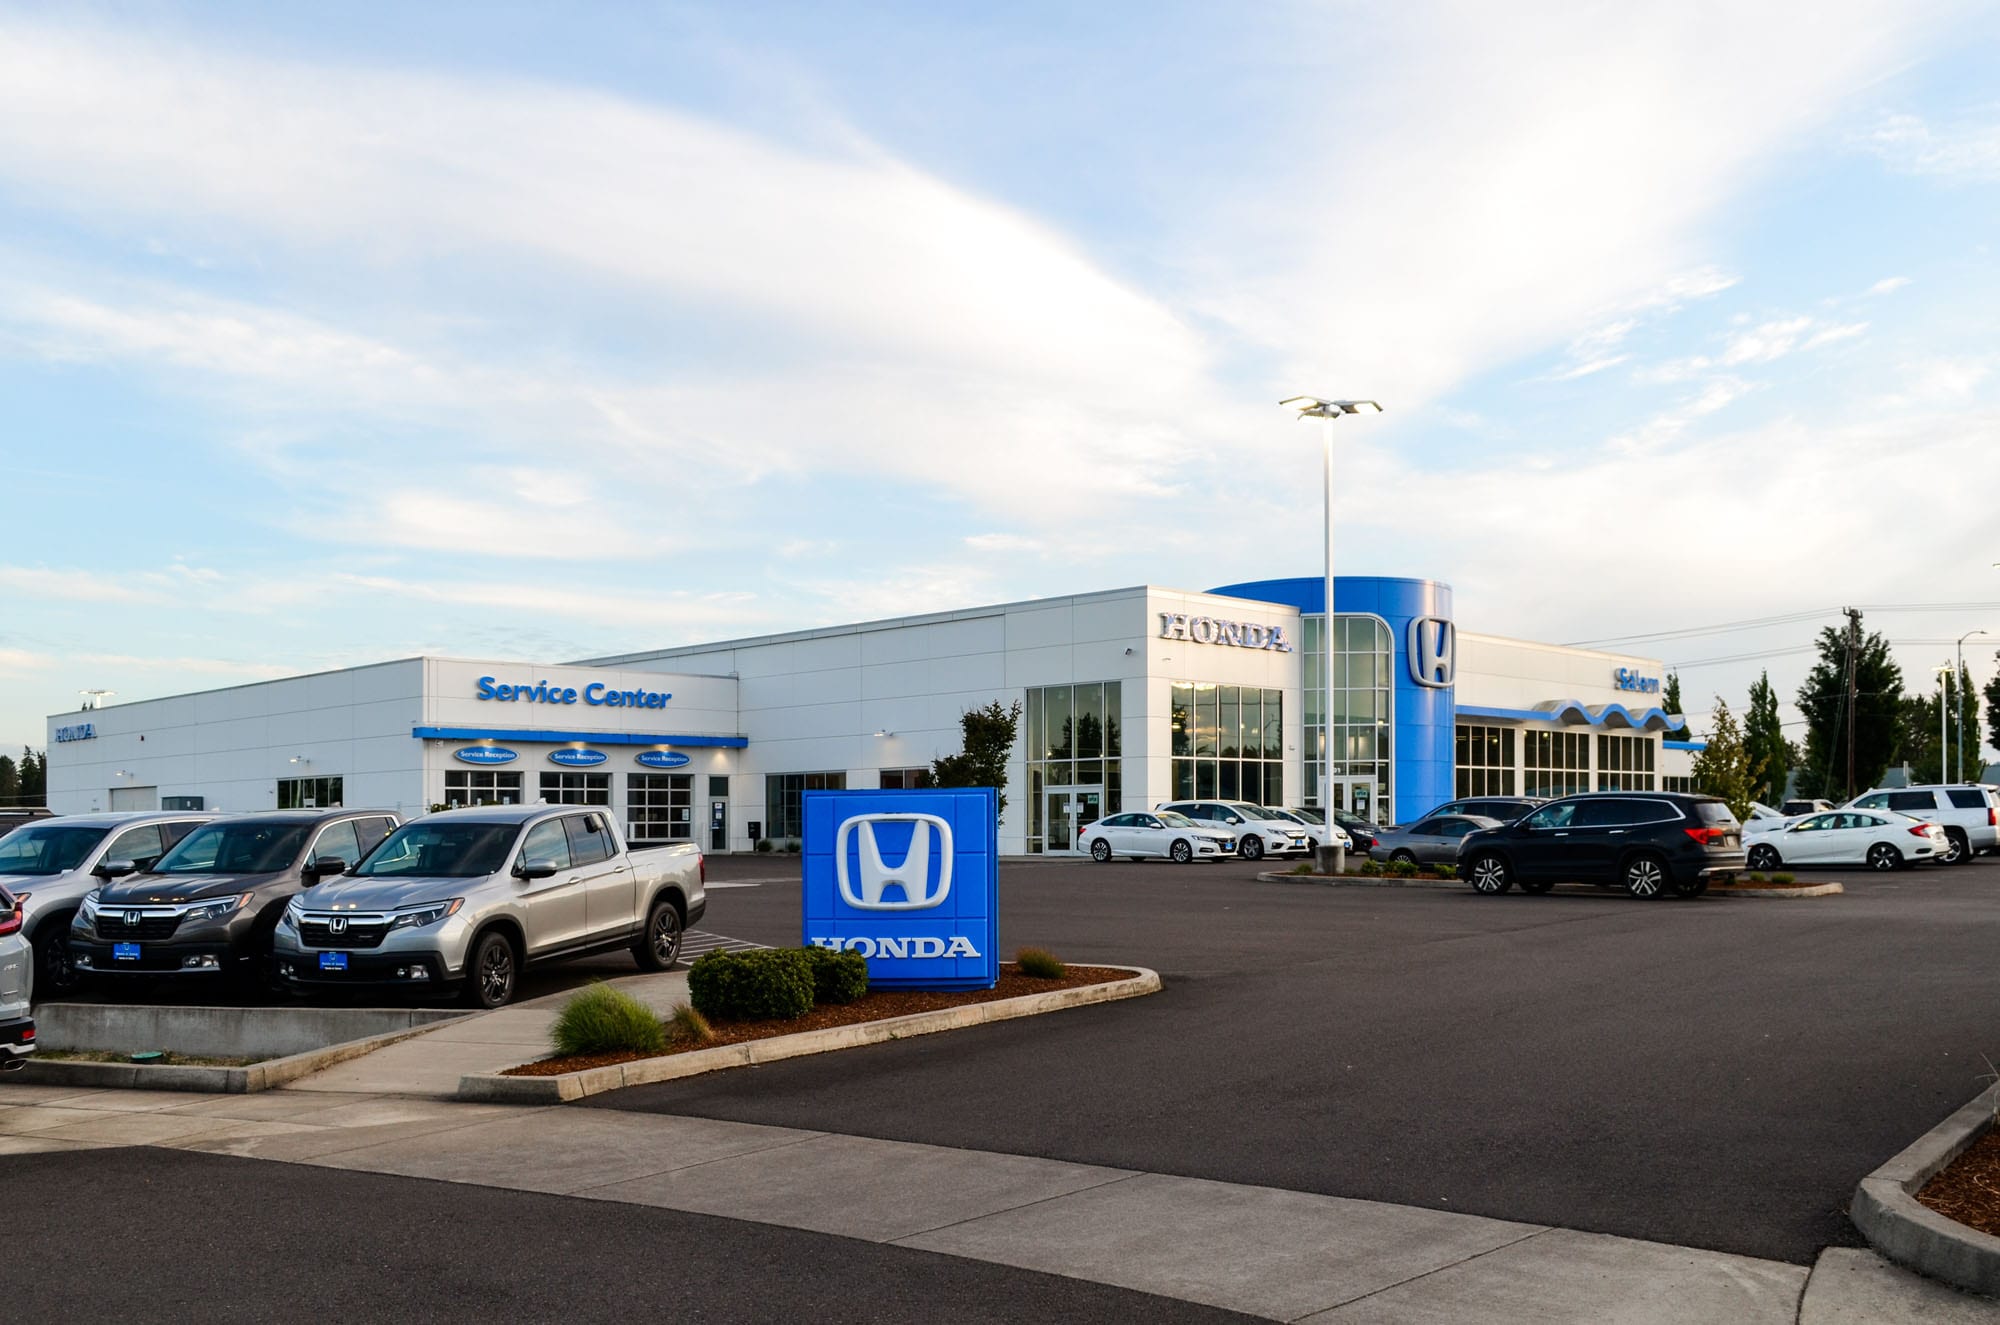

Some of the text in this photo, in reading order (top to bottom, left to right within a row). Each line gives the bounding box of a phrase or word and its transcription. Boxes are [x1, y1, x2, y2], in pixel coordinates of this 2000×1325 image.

[1158, 612, 1290, 652] HONDA
[1614, 667, 1659, 693] Salem
[478, 676, 672, 709] Service Center
[55, 723, 97, 742] HONDA
[460, 750, 515, 760] Service Reception
[577, 753, 605, 761] Reception
[661, 755, 688, 763] Reception
